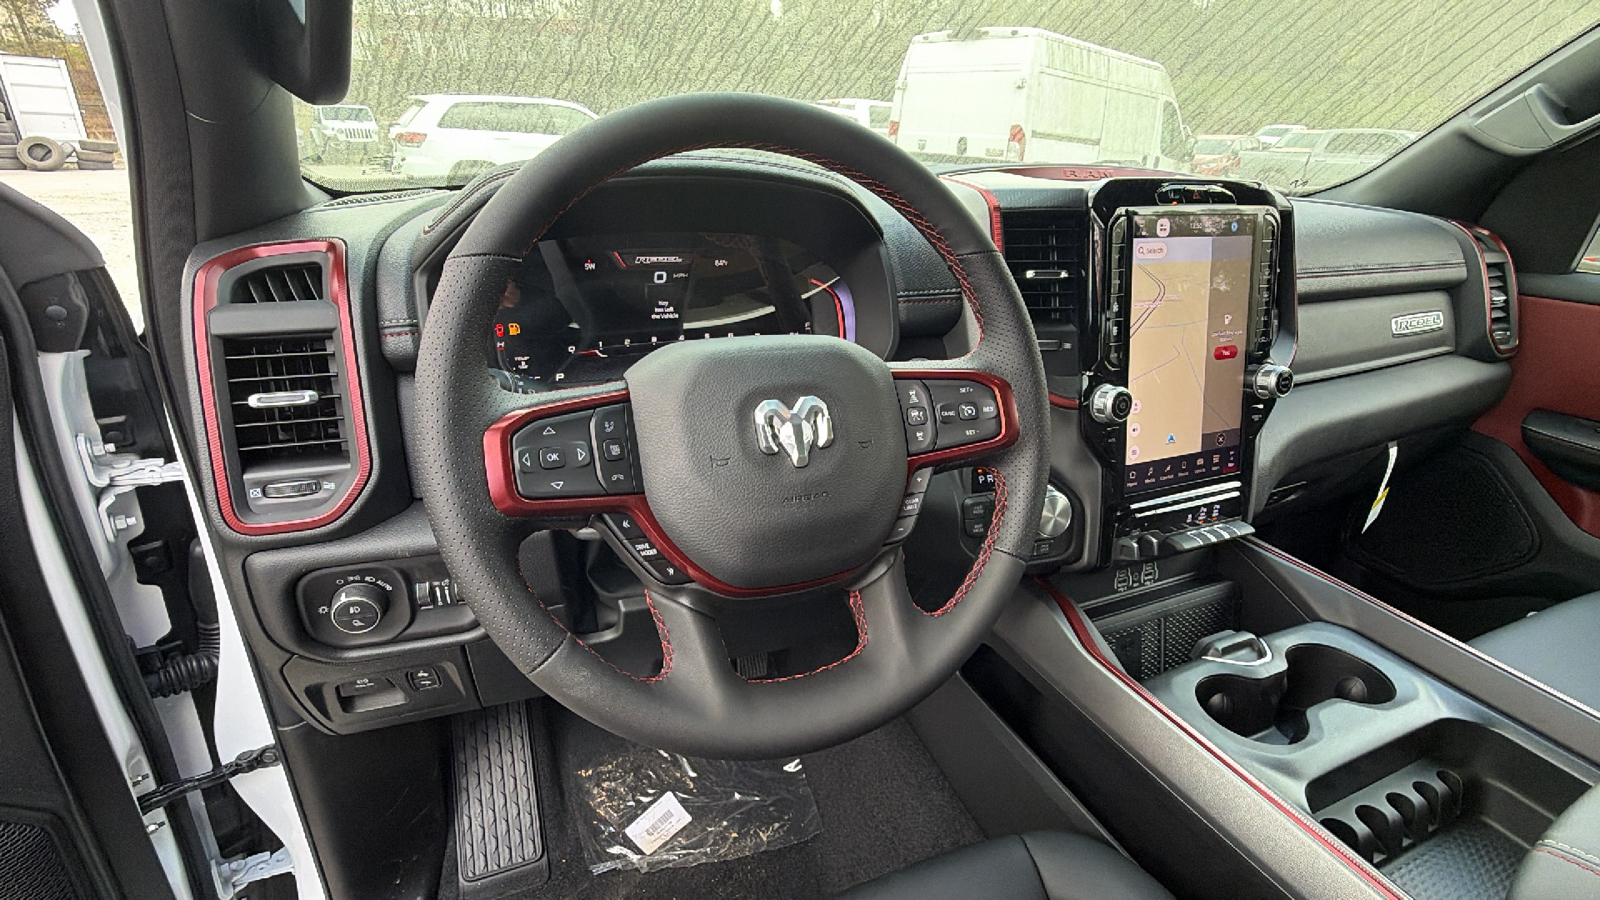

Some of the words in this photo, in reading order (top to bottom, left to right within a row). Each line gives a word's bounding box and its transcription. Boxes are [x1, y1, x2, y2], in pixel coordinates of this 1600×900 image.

[1062, 168, 1114, 179] RAM
[1146, 246, 1164, 254] Search
[556, 373, 565, 381] P
[546, 453, 560, 462] OK
[978, 475, 985, 484] P
[987, 475, 994, 483] R
[376, 580, 392, 591] AUTO
